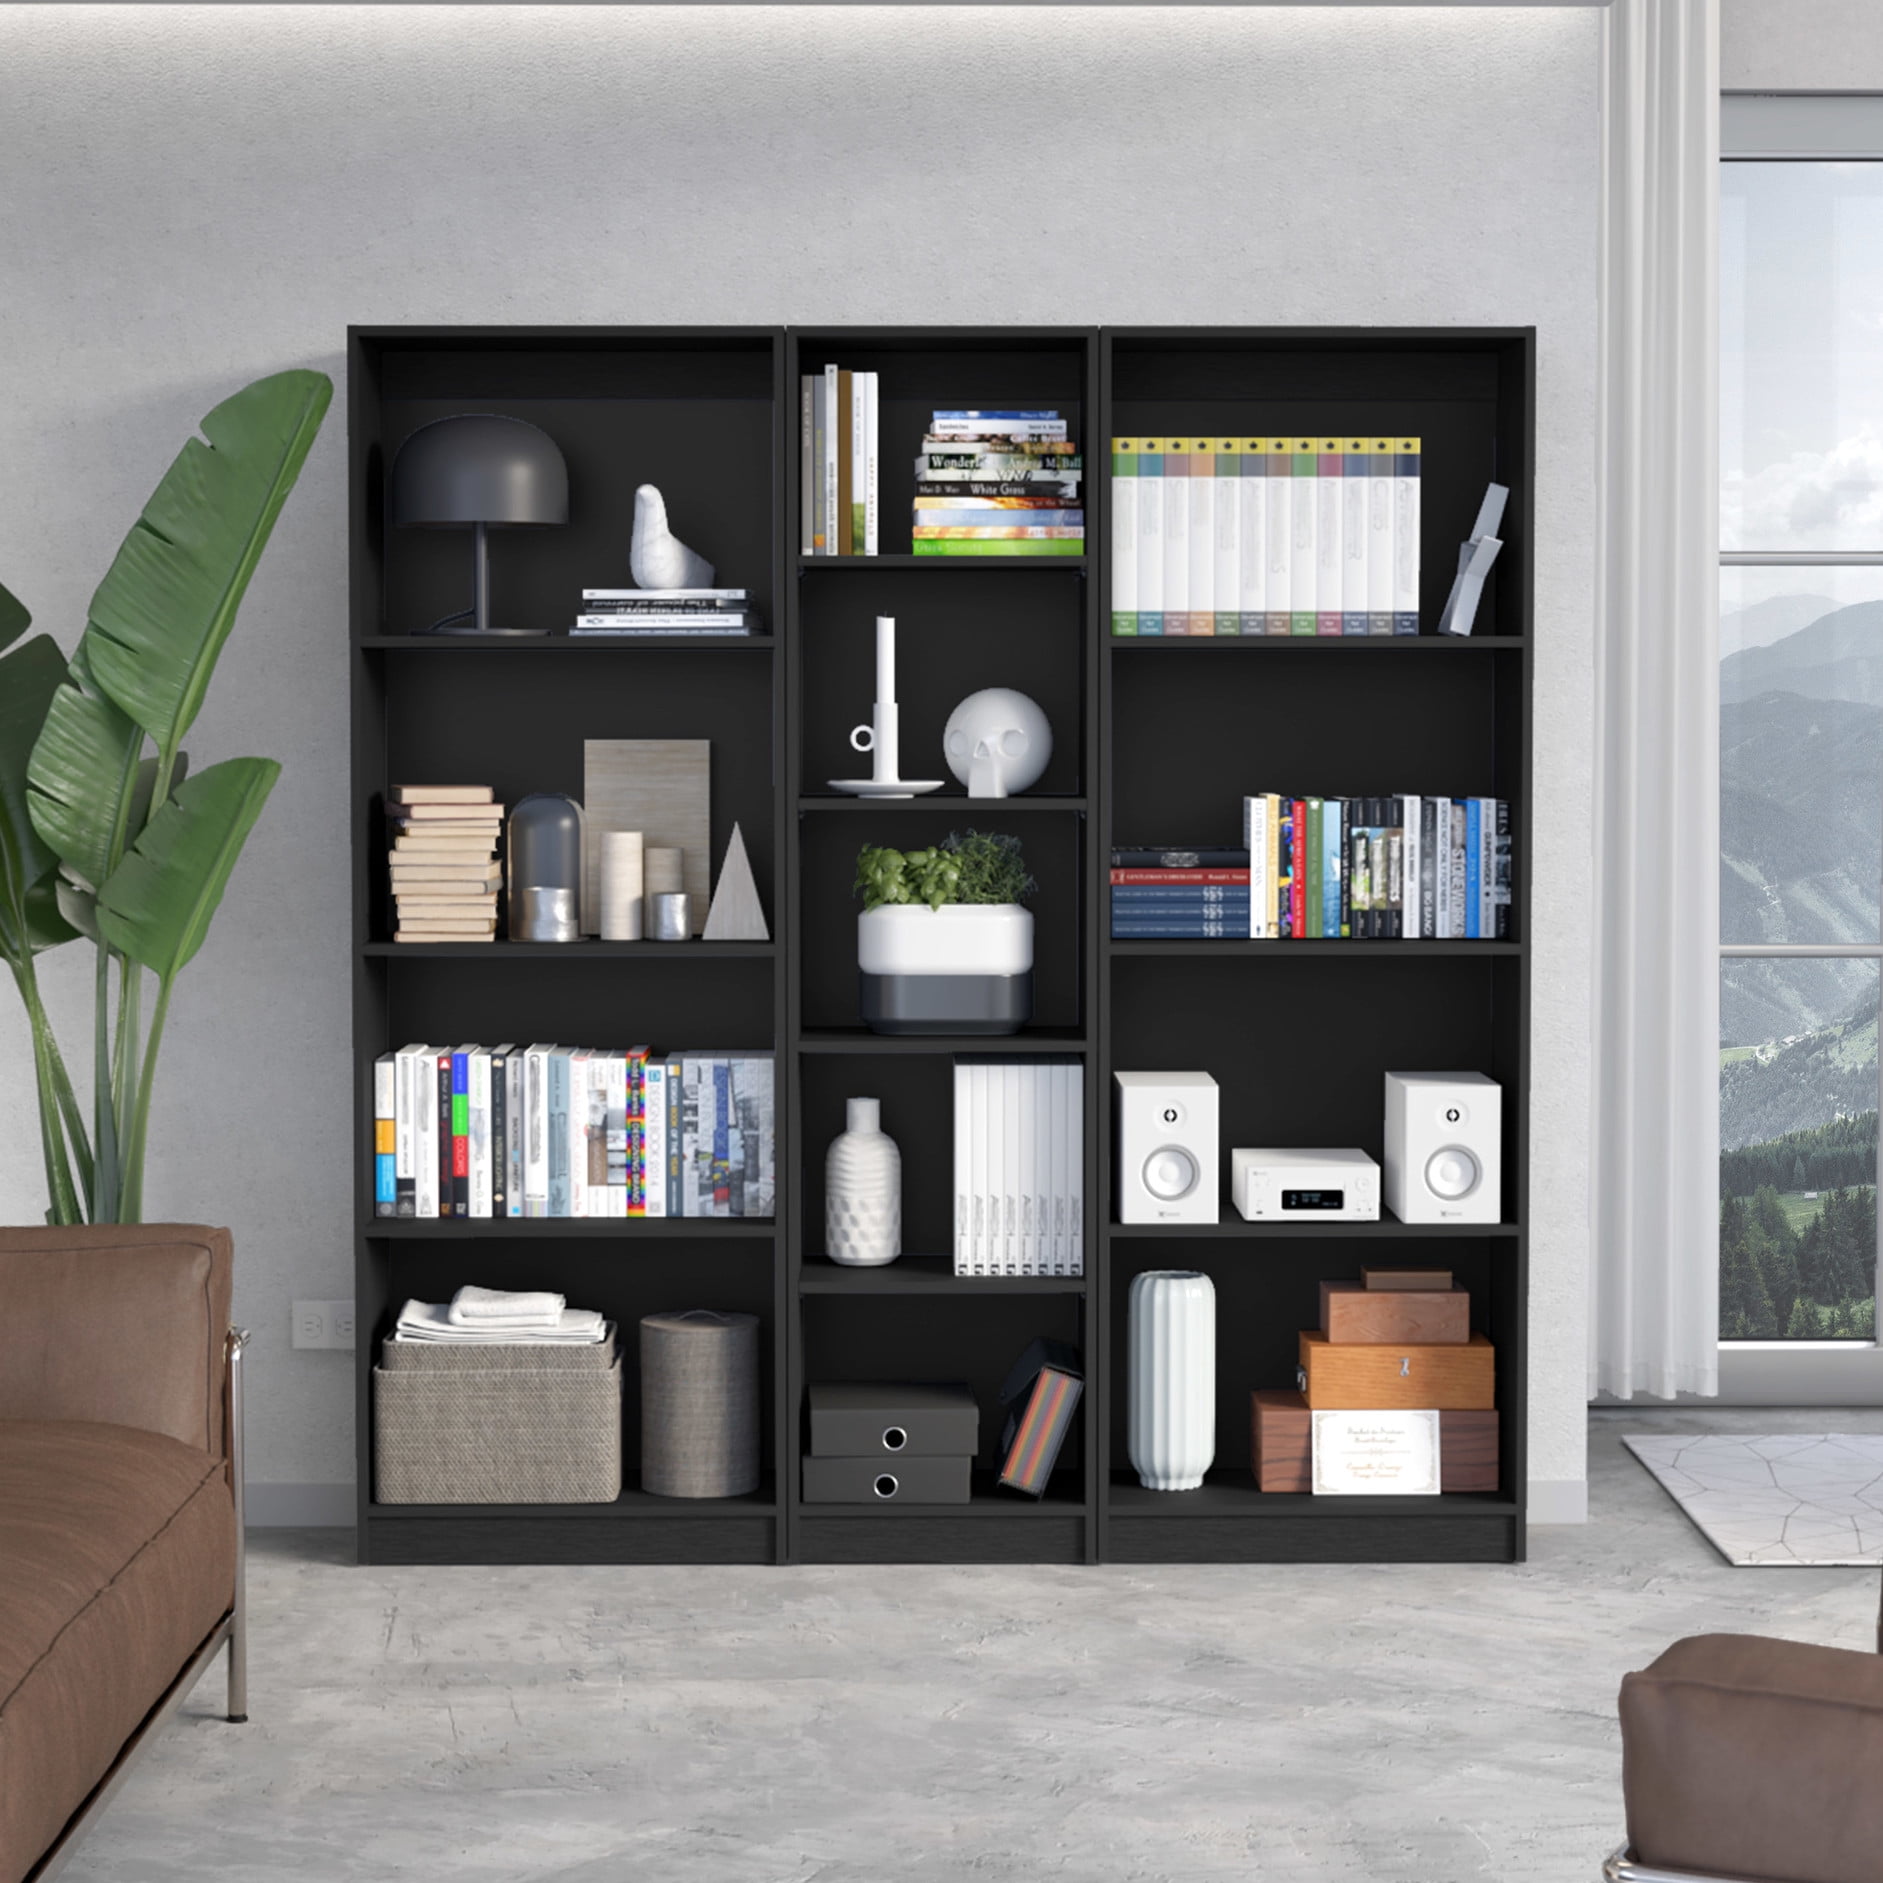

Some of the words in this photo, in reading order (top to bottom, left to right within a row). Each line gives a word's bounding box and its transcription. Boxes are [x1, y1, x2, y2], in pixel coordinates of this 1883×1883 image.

[970, 484, 997, 495] White
[632, 1059, 640, 1077] Todd
[649, 1085, 660, 1123] DESIGN
[670, 1078, 678, 1105] DESIGN
[649, 1126, 660, 1159] BOOK
[670, 1129, 678, 1139] OF
[632, 1123, 640, 1172] DESIGNING
[670, 1141, 678, 1155] THE
[649, 1160, 660, 1186] 2014
[632, 1173, 640, 1204] BRAND
